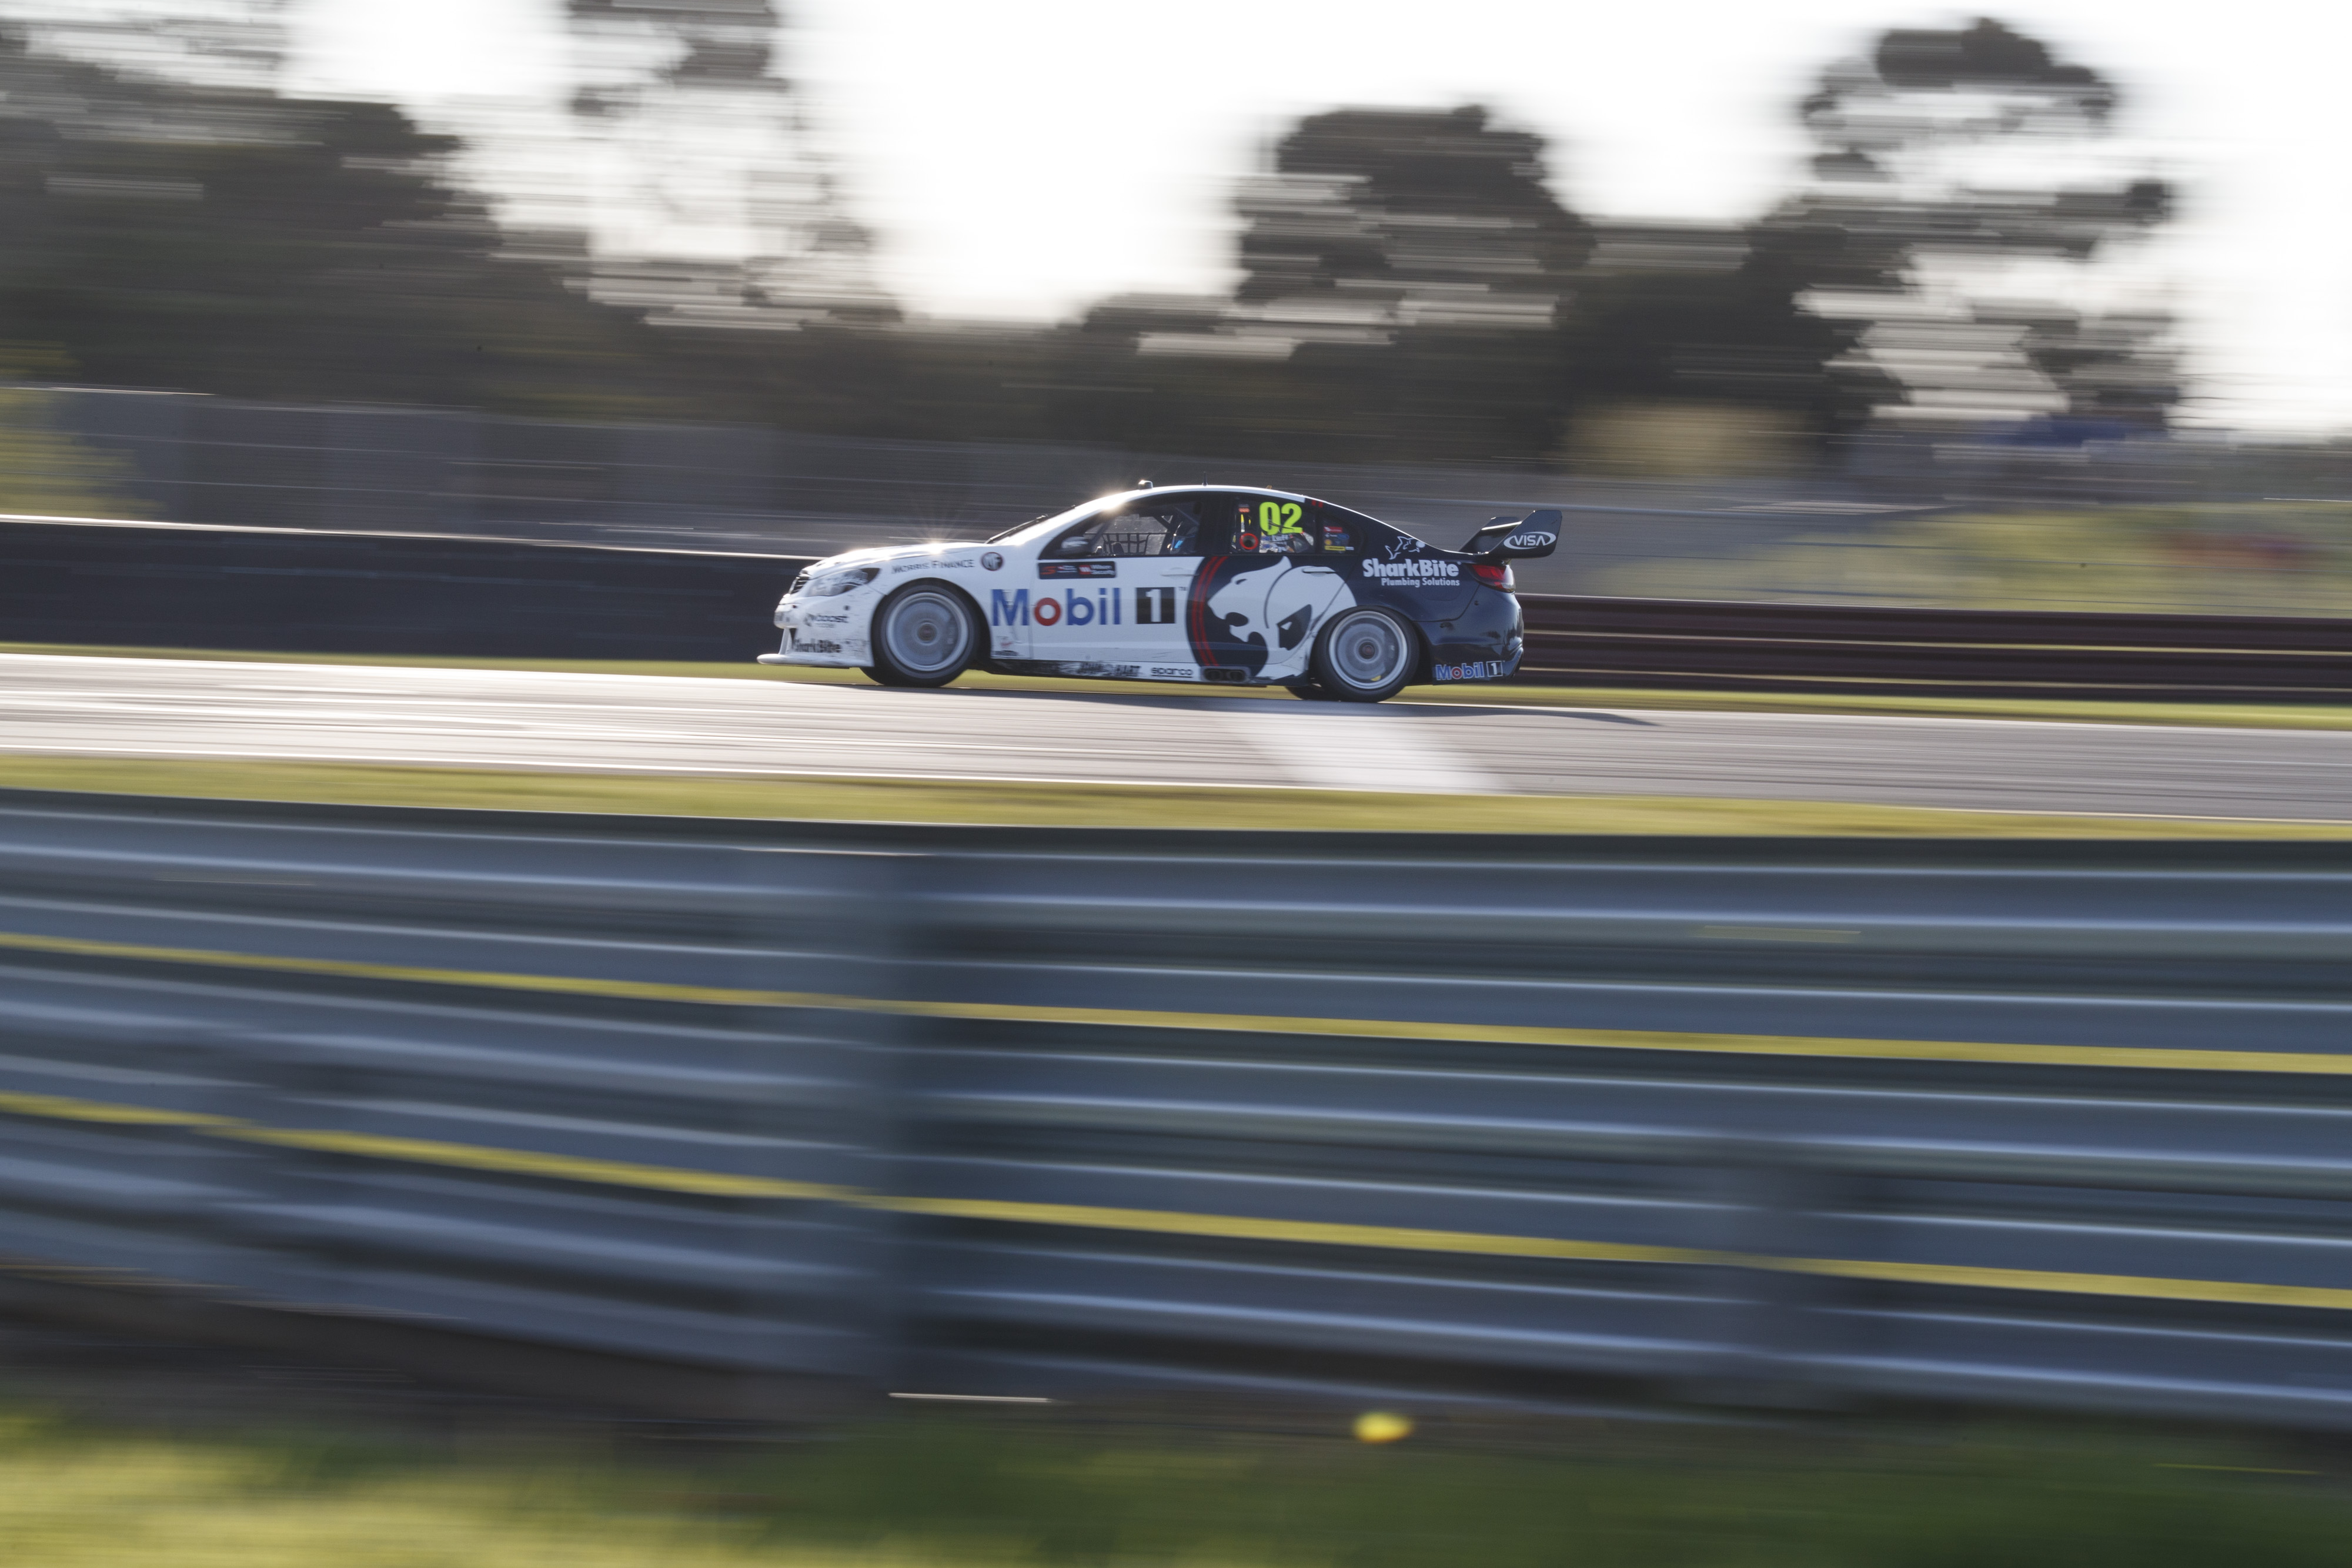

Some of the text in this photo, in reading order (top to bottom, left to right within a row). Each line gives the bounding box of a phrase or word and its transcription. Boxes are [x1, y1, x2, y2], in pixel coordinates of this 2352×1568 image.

[1259, 502, 1303, 536] 02
[1513, 535, 1546, 546] VISA
[1362, 558, 1459, 577] SharkBite
[1381, 578, 1460, 587] Plumbing Solutions
[991, 587, 1121, 626] Mobil
[1151, 667, 1193, 676] sparco
[1435, 661, 1485, 680] Mobil
